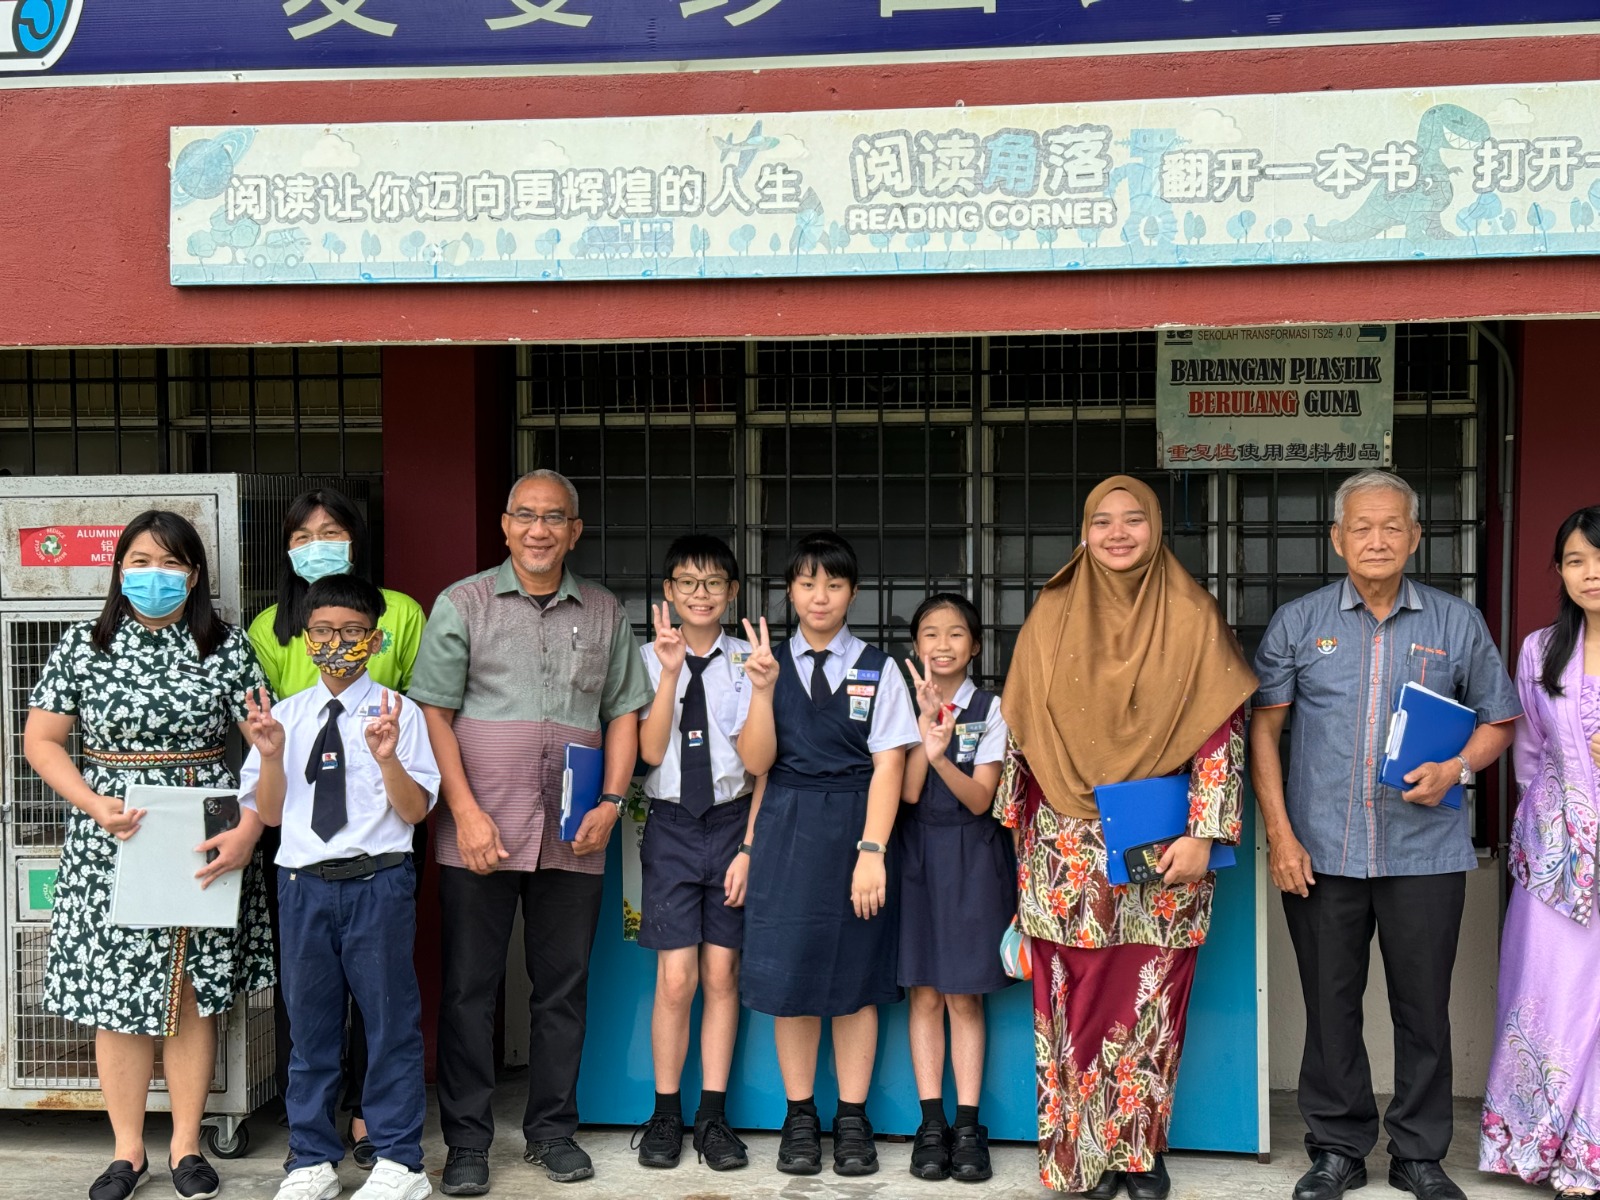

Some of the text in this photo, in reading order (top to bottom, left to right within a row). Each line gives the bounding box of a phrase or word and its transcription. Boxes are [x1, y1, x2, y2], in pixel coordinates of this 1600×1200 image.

[853, 126, 1110, 200] 阅读角落
[226, 163, 801, 222] 阅读让你迈向更辉煌的人生
[848, 200, 1115, 232] READING CORNER
[1197, 330, 1238, 341] SEKOLAH
[1240, 328, 1310, 340] TRANSFORMASI
[1312, 328, 1333, 339] TS25
[1337, 327, 1352, 338] 4.0
[1169, 356, 1381, 384] BARANGAN PLASTIK
[1188, 389, 1361, 416] BERULANG GUNA
[1168, 442, 1381, 462] 重复性使用塑料制品
[101, 540, 114, 553] 铝
